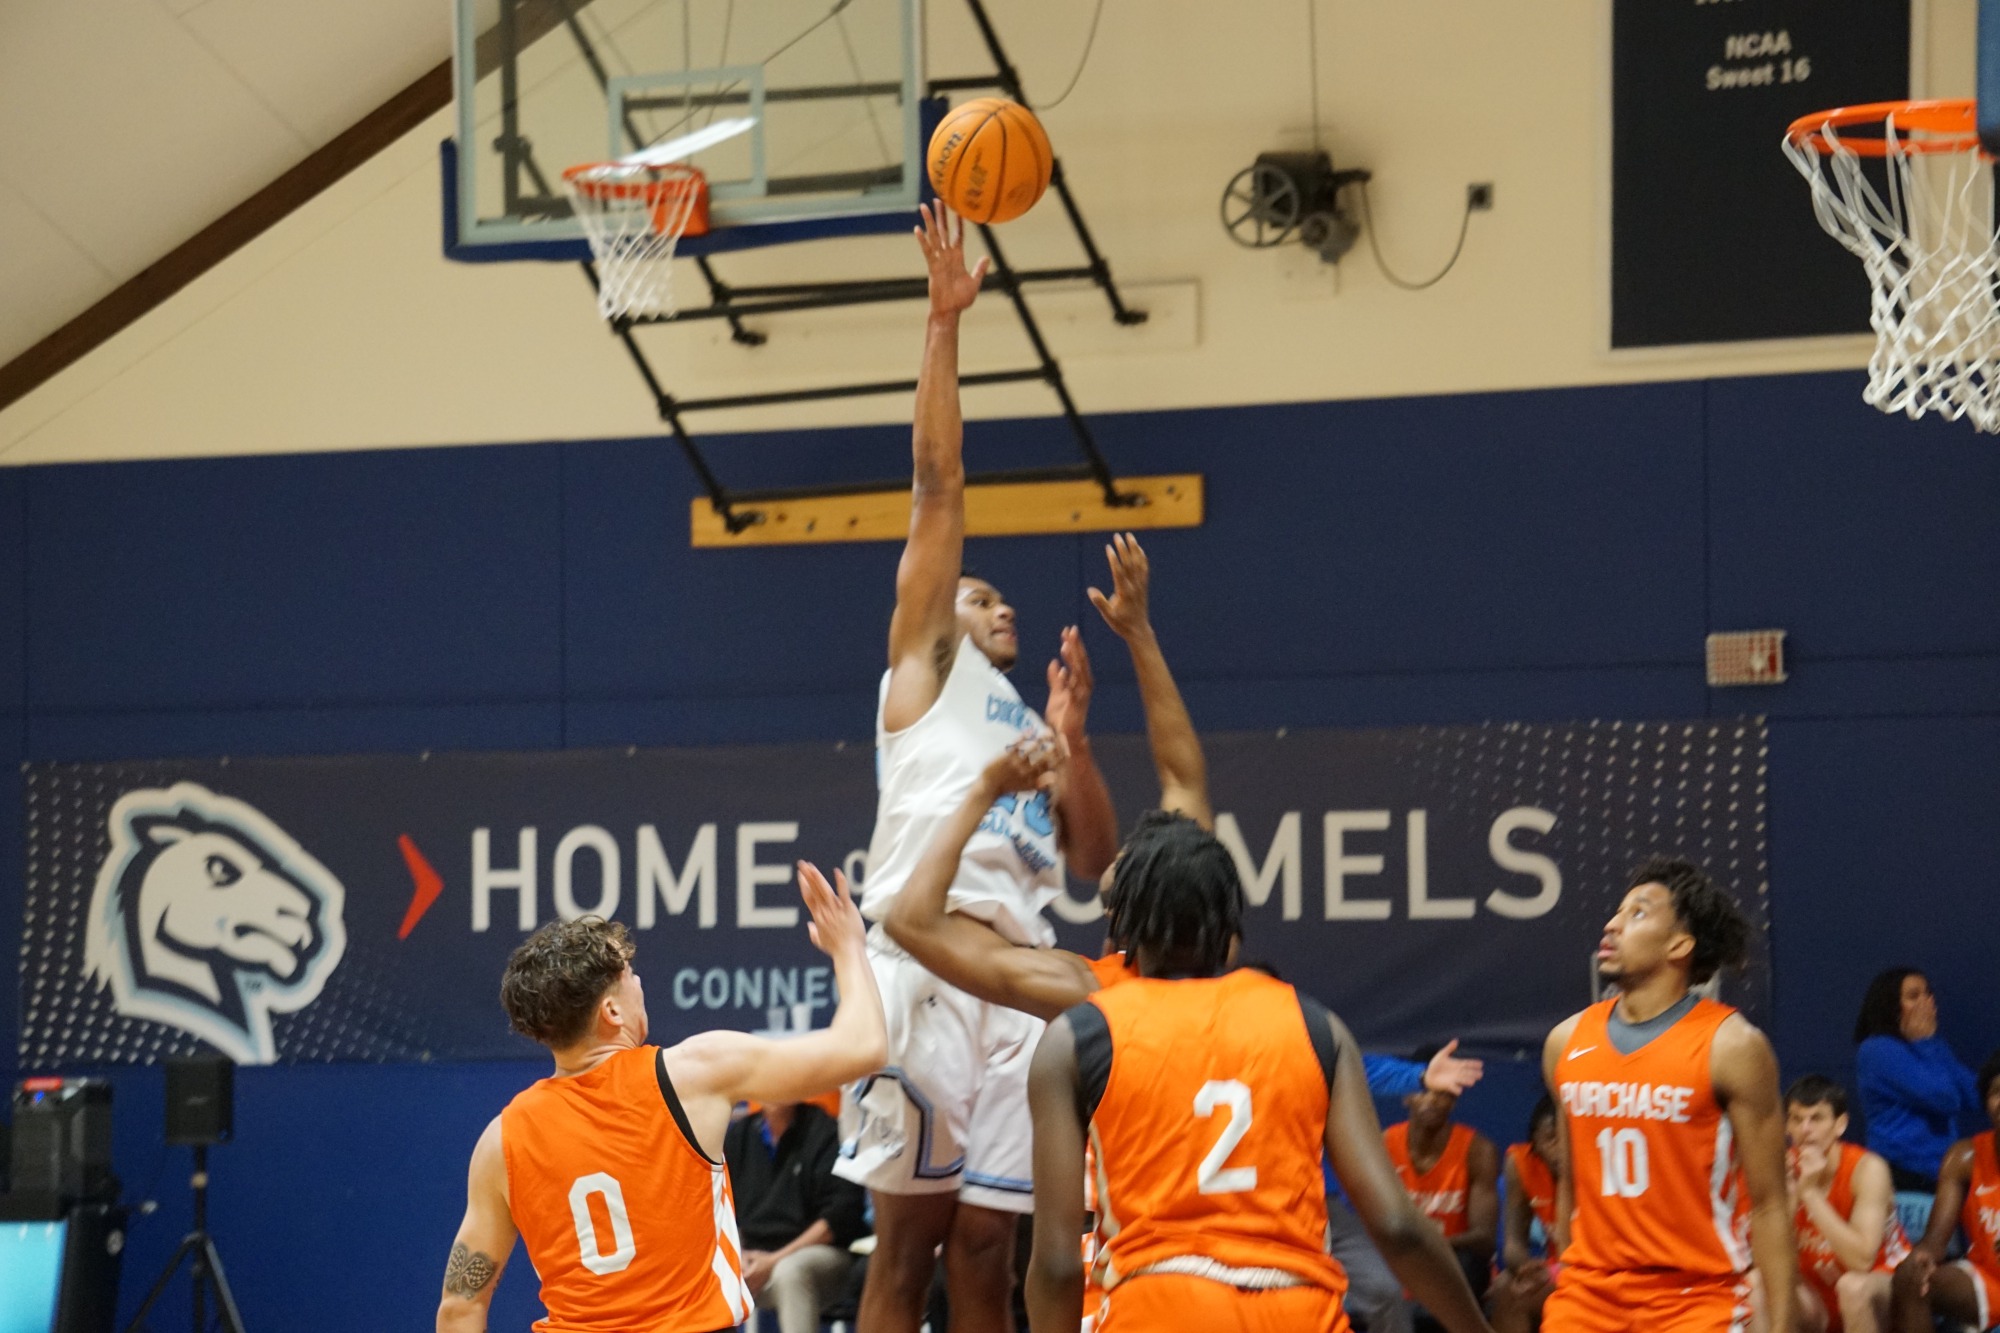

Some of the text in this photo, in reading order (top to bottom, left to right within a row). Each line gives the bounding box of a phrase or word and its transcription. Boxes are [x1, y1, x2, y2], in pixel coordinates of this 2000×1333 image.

[1706, 57, 1811, 90] Sweet 16
[1725, 30, 1791, 60] NCAA
[471, 822, 799, 932] HOME
[673, 967, 841, 1010] CONNE
[1560, 1081, 1694, 1123] PURCHASE
[1193, 1079, 1257, 1194] 2
[1596, 1127, 1650, 1198] 10
[568, 1171, 636, 1275] 0
